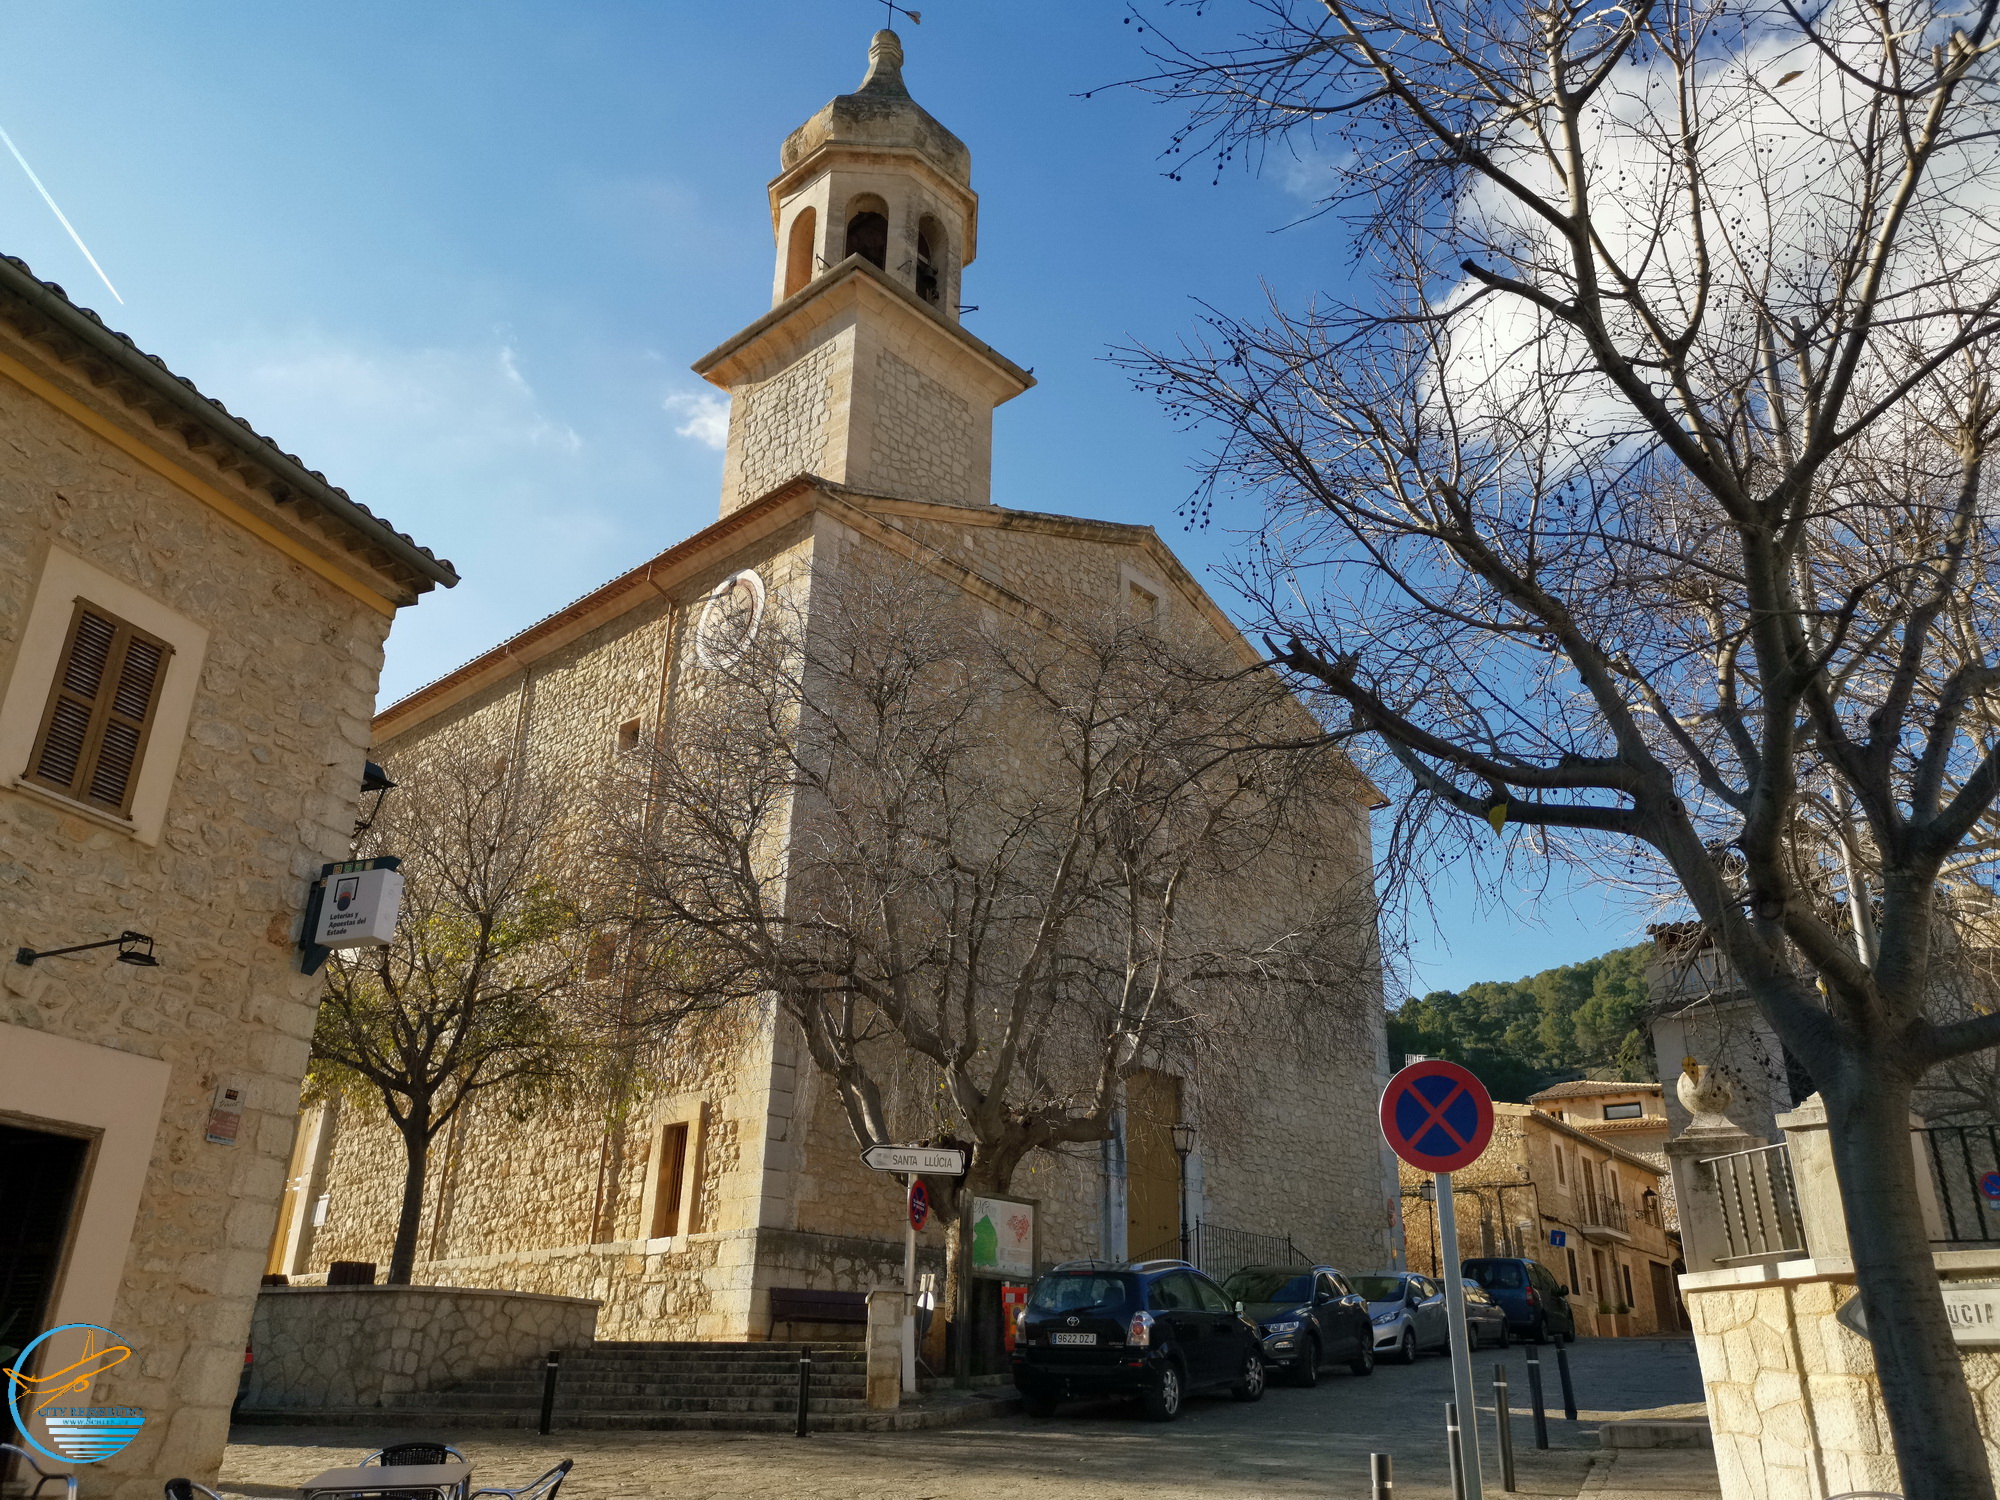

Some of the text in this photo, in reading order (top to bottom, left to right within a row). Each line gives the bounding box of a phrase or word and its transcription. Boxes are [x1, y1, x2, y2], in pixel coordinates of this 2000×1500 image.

[330, 912, 354, 920] Loterías
[328, 917, 367, 929] Apuestas del
[326, 927, 347, 936] Estado
[892, 1153, 953, 1168] SANTA LLÚCIA
[1946, 1303, 1993, 1324] UCIA
[1057, 1334, 1096, 1344] 9622 DZJ
